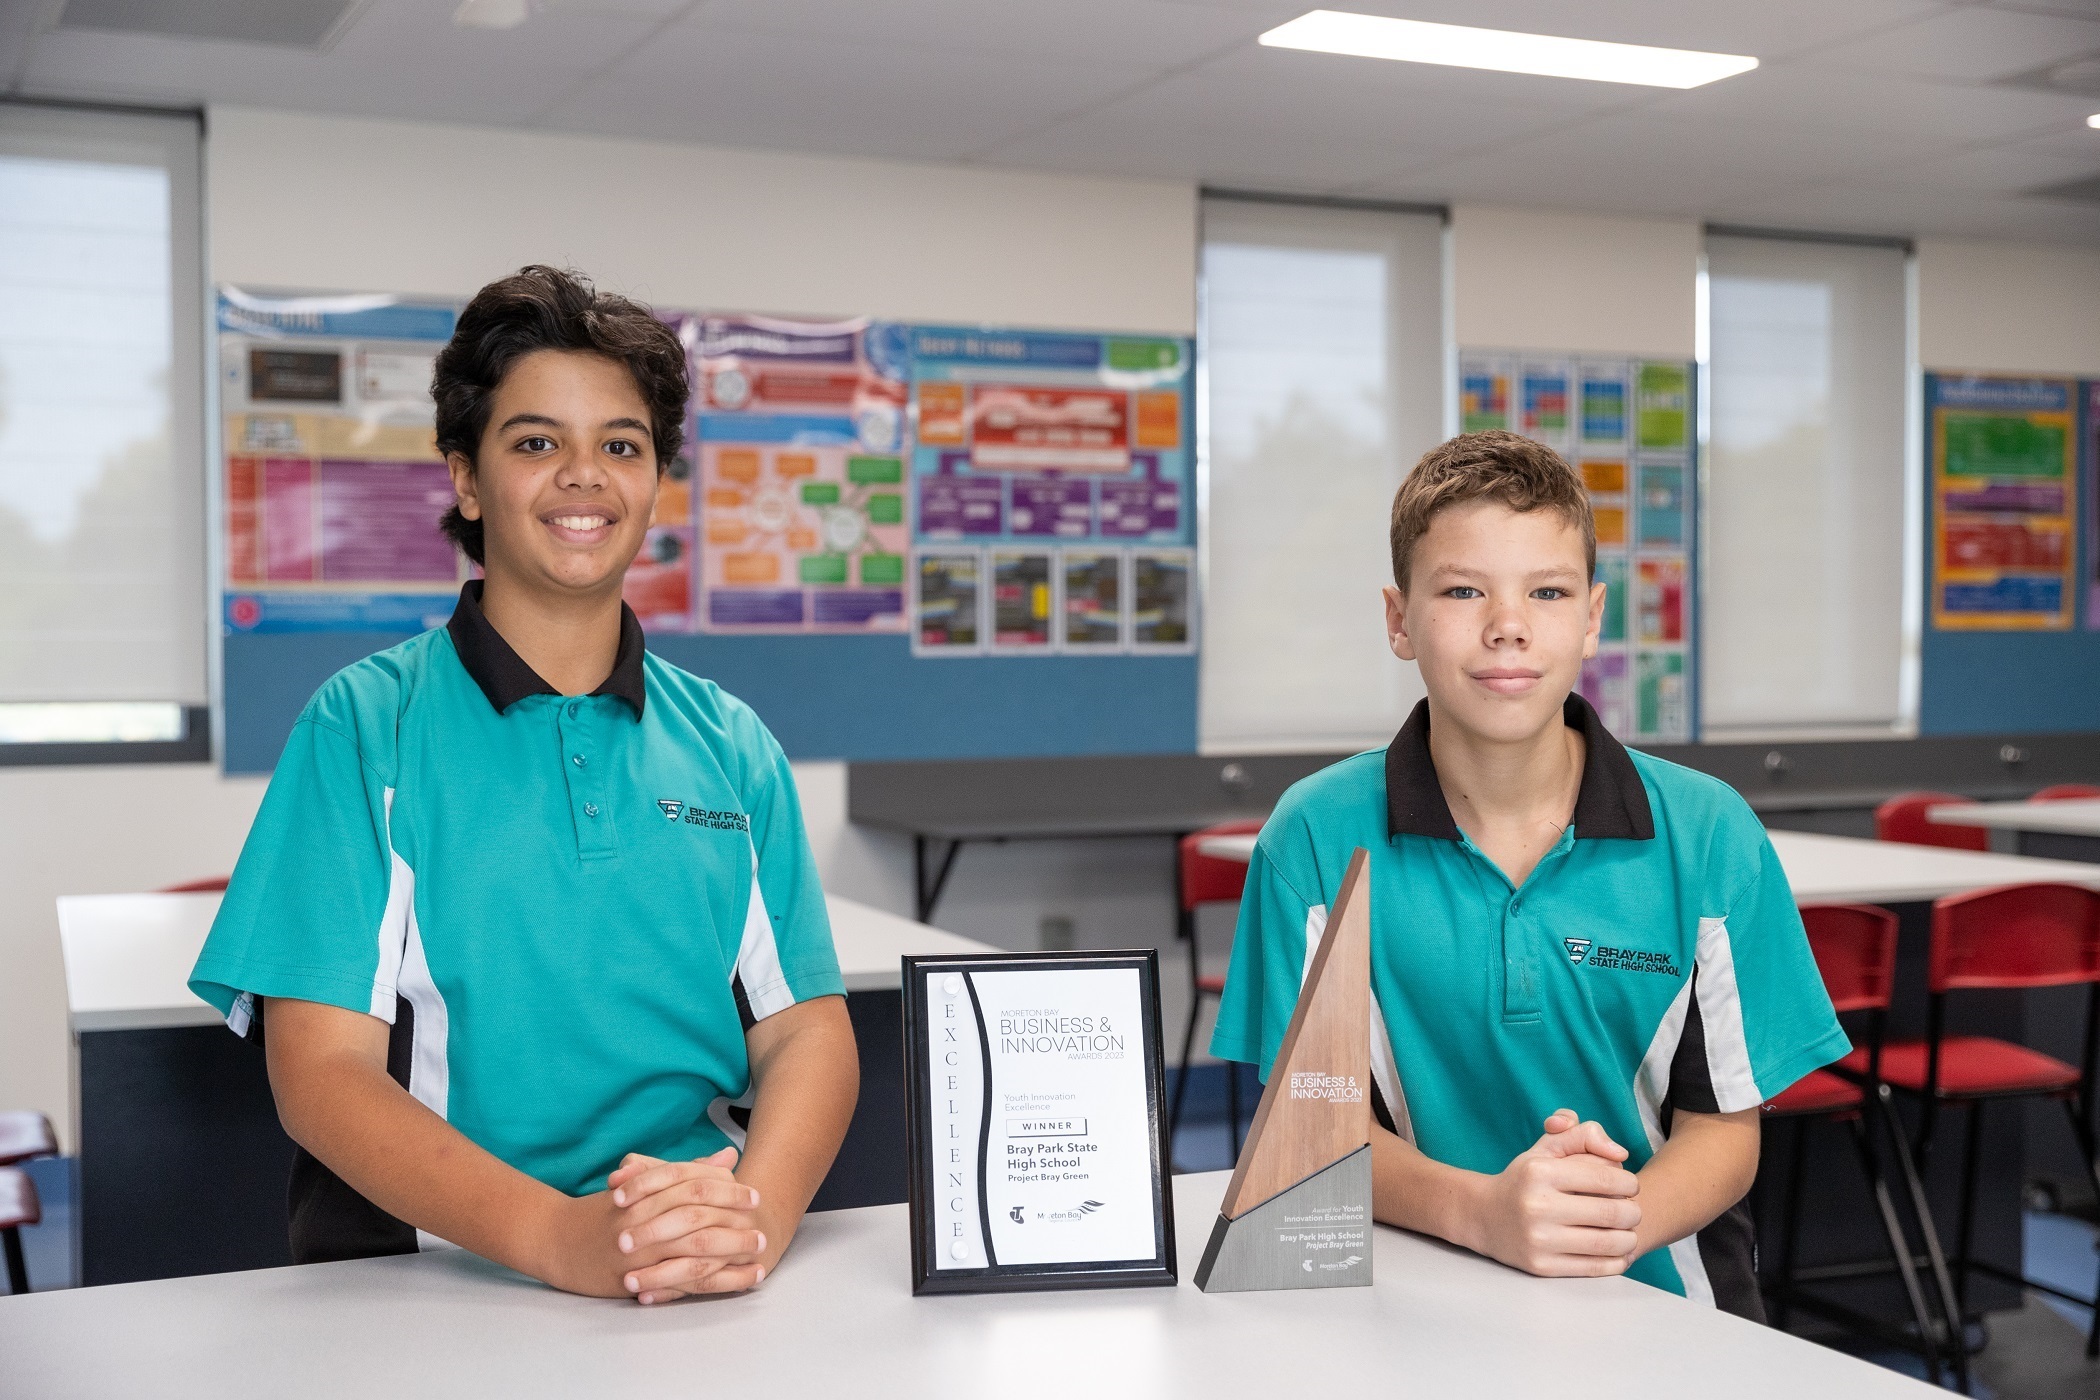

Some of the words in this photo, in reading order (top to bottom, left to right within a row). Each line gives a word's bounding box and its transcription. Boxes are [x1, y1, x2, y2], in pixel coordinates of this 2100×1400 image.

[689, 807, 722, 820] BRAY
[723, 812, 748, 825] PAR
[684, 815, 709, 828] STATE
[710, 820, 735, 830] HIGH
[1597, 946, 1638, 961] BRAY
[1637, 952, 1672, 965] PARK
[1588, 956, 1619, 969] STATE
[1620, 961, 1644, 972] HIGH
[1644, 964, 1680, 977] SCHOOL
[1000, 1009, 1042, 1018] MORETON
[1044, 1008, 1060, 1017] BAY
[1000, 1017, 1094, 1035] BUSINESS
[1099, 1016, 1113, 1033] &
[1001, 1035, 1124, 1054] INNOVATION
[1067, 1052, 1103, 1061] AWARDS
[1104, 1051, 1125, 1060] 2023
[1291, 1077, 1345, 1088] BUSINESS
[1348, 1077, 1356, 1087] &
[1004, 1093, 1029, 1102] Youth
[1031, 1092, 1076, 1101] Innovation
[1291, 1087, 1363, 1099] INNOVATION
[1004, 1103, 1051, 1112] Excellence
[944, 1003, 964, 1237] EXCELLENCE
[1022, 1121, 1073, 1131] WINNER
[1007, 1144, 1034, 1157] Bray
[1037, 1143, 1064, 1154] Park
[1067, 1142, 1098, 1153] State
[1007, 1158, 1037, 1172] High
[1039, 1156, 1081, 1168] School
[1008, 1174, 1039, 1183] Project
[1040, 1173, 1061, 1182] Bray
[1062, 1172, 1089, 1180] Green
[1342, 1205, 1364, 1213] Youth
[1284, 1214, 1323, 1223] Innovation
[1324, 1213, 1364, 1221] Excellence
[1280, 1234, 1298, 1243] Bray
[1299, 1233, 1317, 1241] Park
[1317, 1232, 1337, 1242] High
[1338, 1231, 1364, 1240] School
[1306, 1241, 1328, 1250] Project
[1329, 1241, 1344, 1250] Bray
